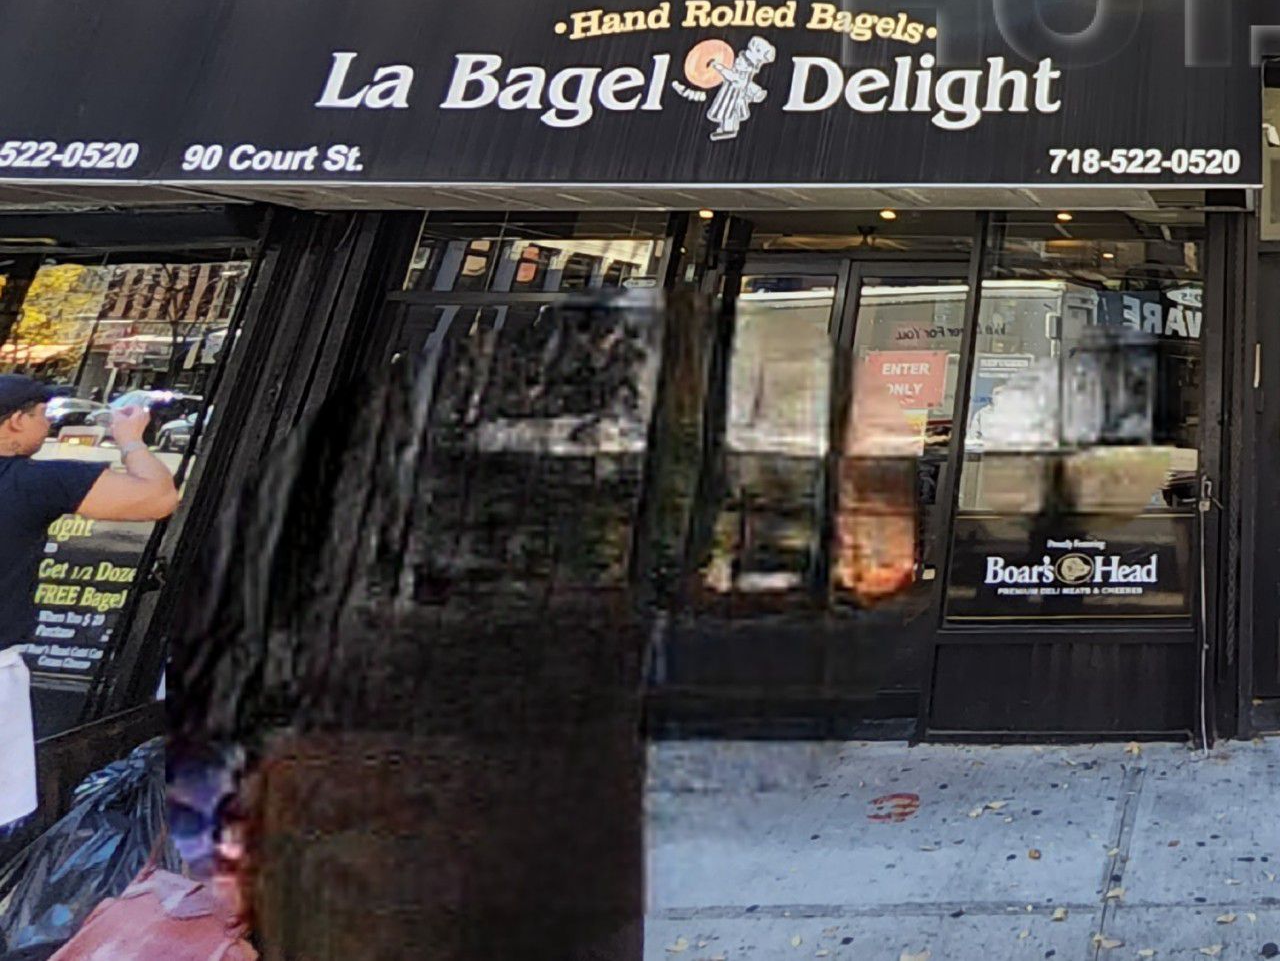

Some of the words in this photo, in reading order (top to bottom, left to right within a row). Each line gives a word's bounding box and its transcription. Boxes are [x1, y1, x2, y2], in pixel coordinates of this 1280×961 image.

[569, 1, 671, 41] Hand
[682, 0, 797, 30] Rolled
[806, 3, 925, 44] Bagels
[315, 52, 413, 110] La
[440, 52, 671, 129] Bagel
[782, 53, 1063, 131] Delight
[0, 140, 140, 169] 522-0520
[182, 144, 224, 172] 90
[228, 145, 319, 172] Court
[322, 144, 365, 172] St.
[1048, 148, 1241, 175] 718-522-0520
[881, 362, 931, 376] ENTER
[38, 558, 70, 580] Get
[984, 554, 1056, 585] Boar's
[1093, 552, 1159, 584] Head
[34, 583, 82, 606] FREE
